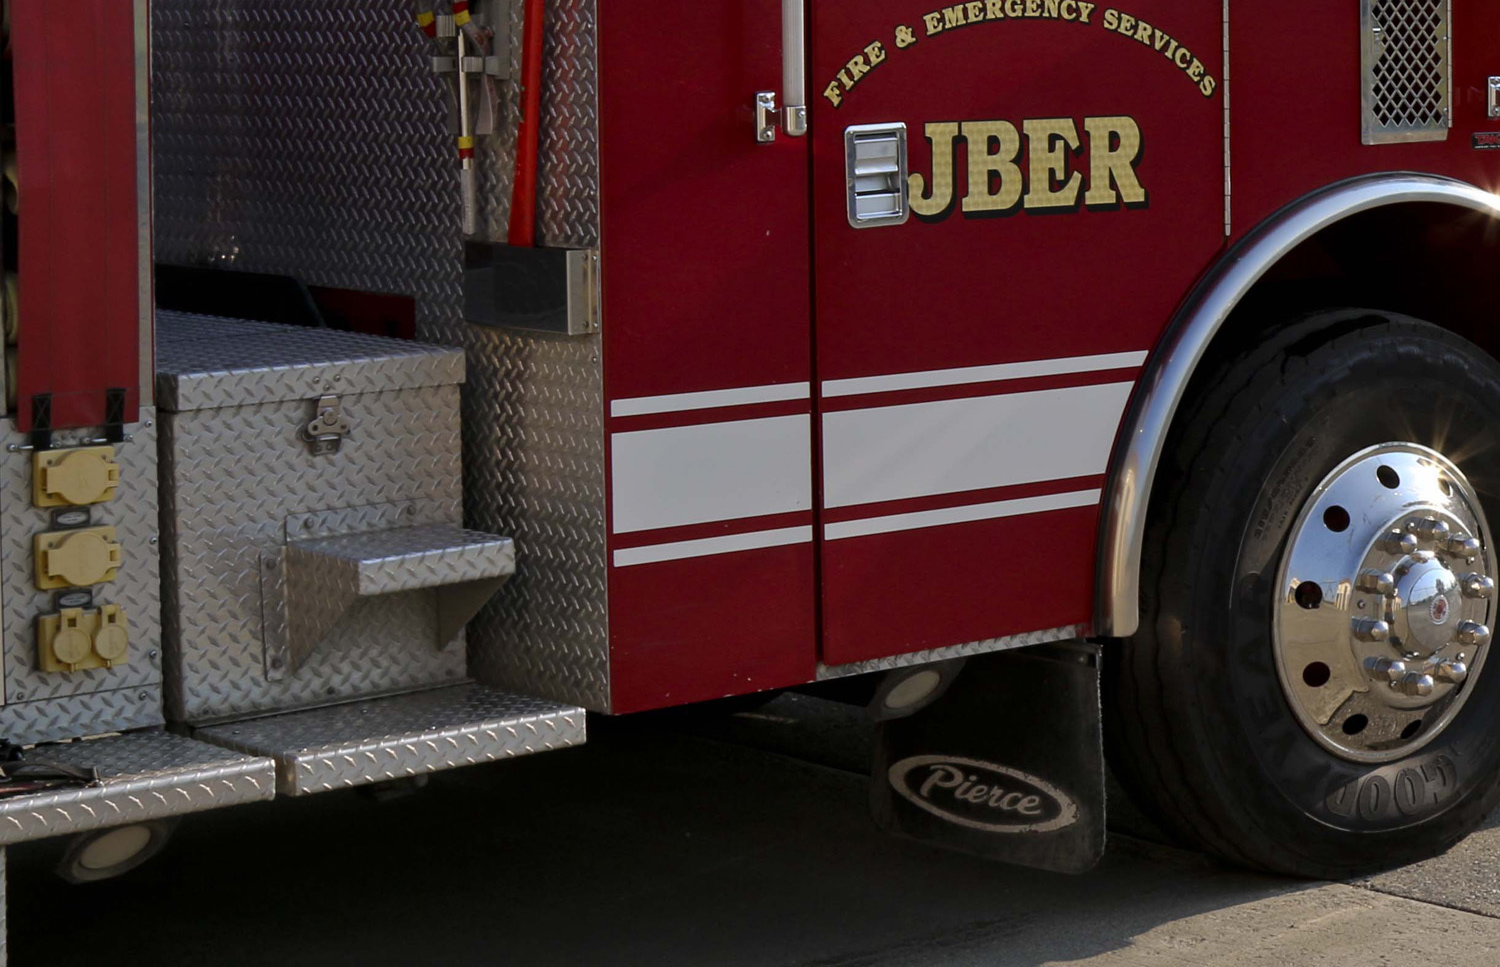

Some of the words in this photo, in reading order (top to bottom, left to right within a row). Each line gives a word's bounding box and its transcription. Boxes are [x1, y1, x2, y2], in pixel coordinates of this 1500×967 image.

[823, 41, 886, 108] FIRE
[894, 24, 916, 49] &
[1103, 8, 1217, 98] SERVICES
[906, 115, 1149, 221] JBER
[920, 764, 1042, 816] Pierce
